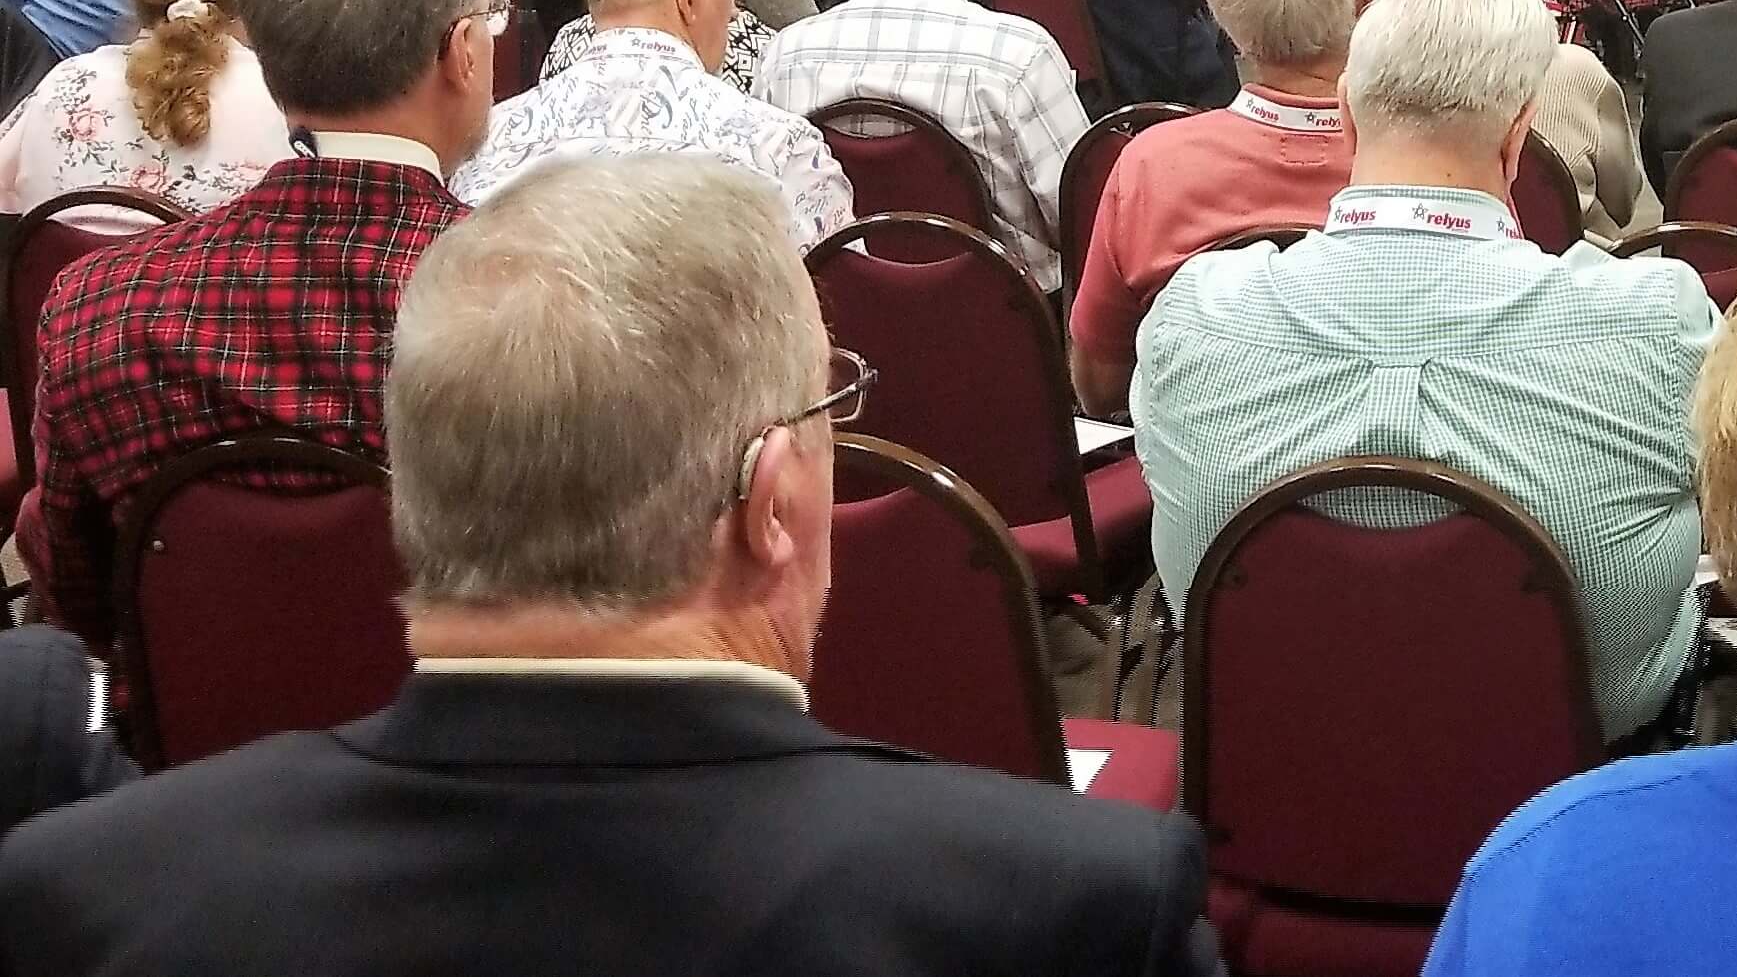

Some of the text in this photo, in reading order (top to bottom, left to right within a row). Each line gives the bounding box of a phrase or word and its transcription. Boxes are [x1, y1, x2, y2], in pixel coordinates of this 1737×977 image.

[1251, 105, 1279, 121] relyus
[1340, 208, 1376, 225] relyus
[1427, 212, 1471, 229] relyus
